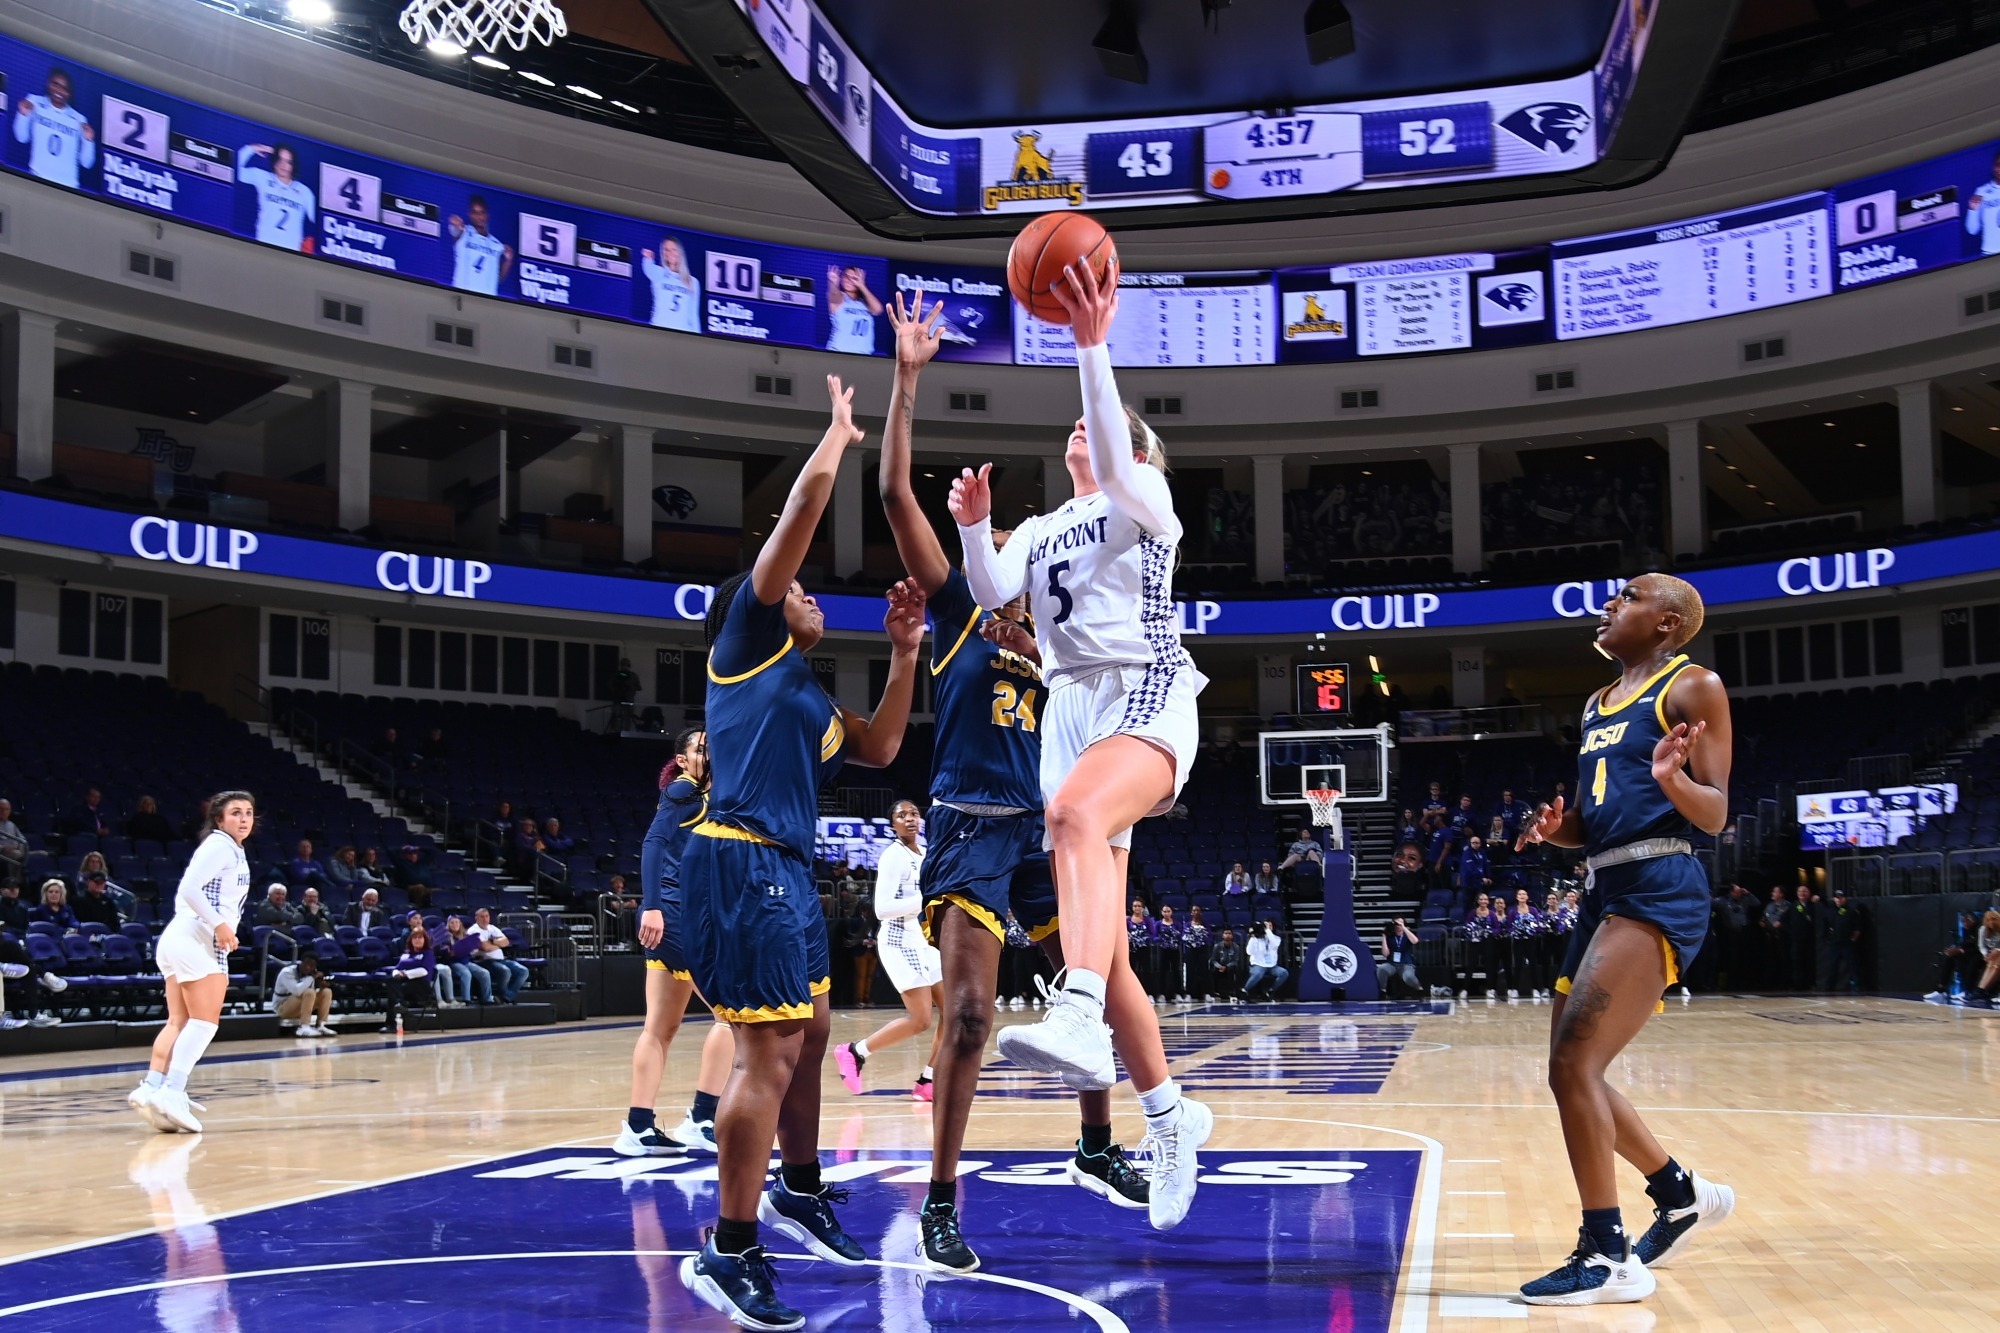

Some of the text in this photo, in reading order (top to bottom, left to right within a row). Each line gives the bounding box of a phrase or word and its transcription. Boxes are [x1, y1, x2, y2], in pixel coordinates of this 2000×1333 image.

[122, 110, 146, 150] 2
[1245, 118, 1315, 148] 4:57
[1399, 118, 1457, 157] 52
[1118, 141, 1173, 178] 43
[338, 177, 361, 211] 4
[1259, 168, 1303, 187] 4TH
[1856, 201, 1877, 235] 0
[538, 224, 560, 258] 5
[520, 262, 571, 287] Claire
[520, 279, 570, 304] Wyatt
[714, 259, 754, 293] 10
[130, 426, 196, 473] HPU
[129, 515, 259, 571] CULP
[1052, 516, 1107, 555] POINT
[375, 550, 493, 599] CULP
[1776, 548, 1896, 596] CULP
[1048, 559, 1073, 626] 5
[1552, 578, 1627, 618] CU
[305, 621, 329, 636] 106
[1330, 593, 1440, 631] CULP
[658, 651, 681, 665] 106
[814, 660, 835, 673] 105
[1264, 667, 1285, 679] 105
[1457, 660, 1479, 672] 104
[991, 680, 1037, 733] 24
[1580, 721, 1629, 755] JCSU
[1592, 757, 1607, 806] 4
